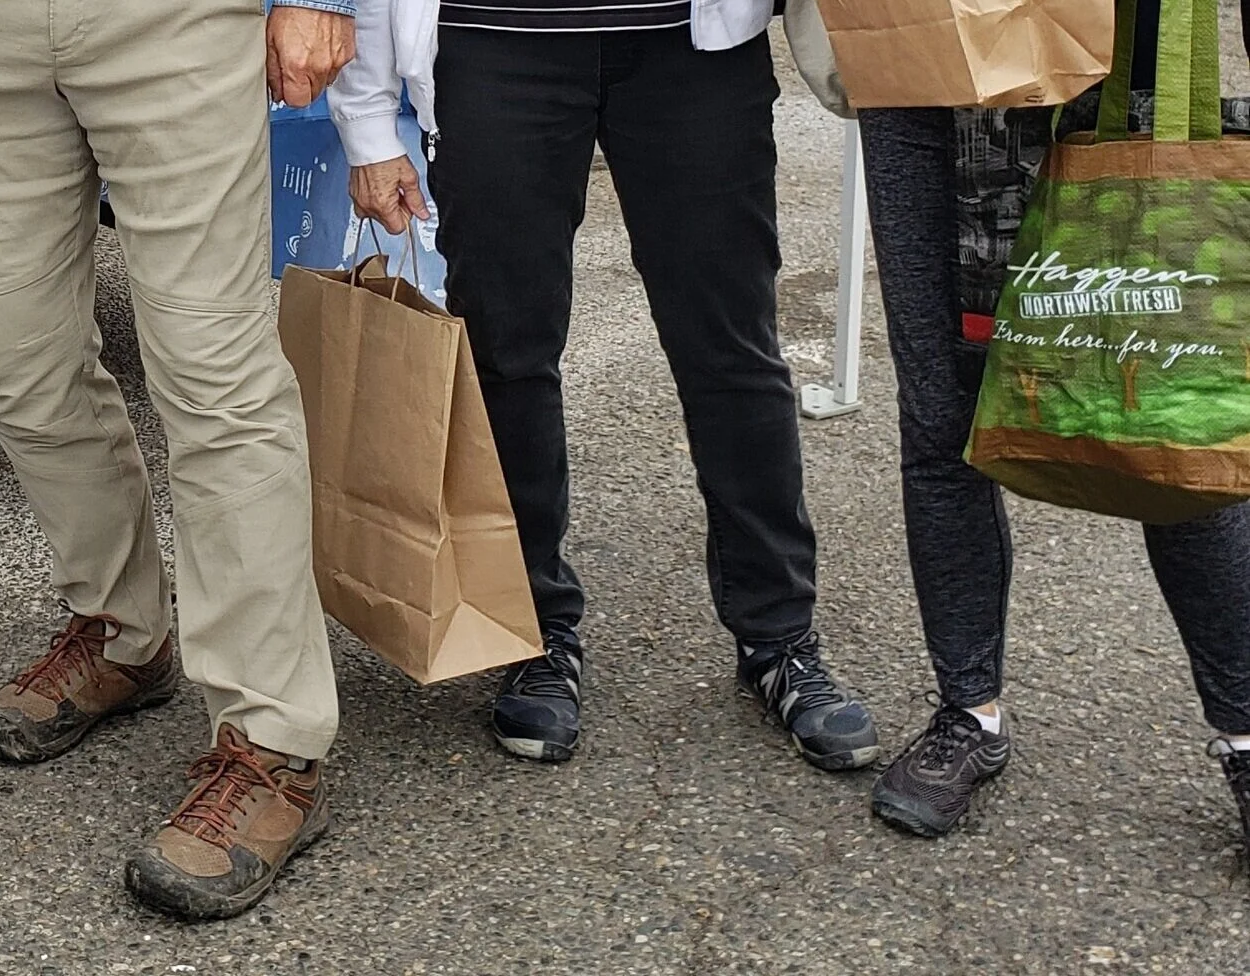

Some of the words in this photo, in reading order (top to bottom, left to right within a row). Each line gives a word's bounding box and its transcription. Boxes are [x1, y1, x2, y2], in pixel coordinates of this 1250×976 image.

[1007, 251, 1219, 293] Haggen
[1022, 291, 1116, 316] NORTHWEST
[1123, 288, 1175, 312] FRESH
[993, 320, 1047, 347] From
[1162, 339, 1224, 369] you.
